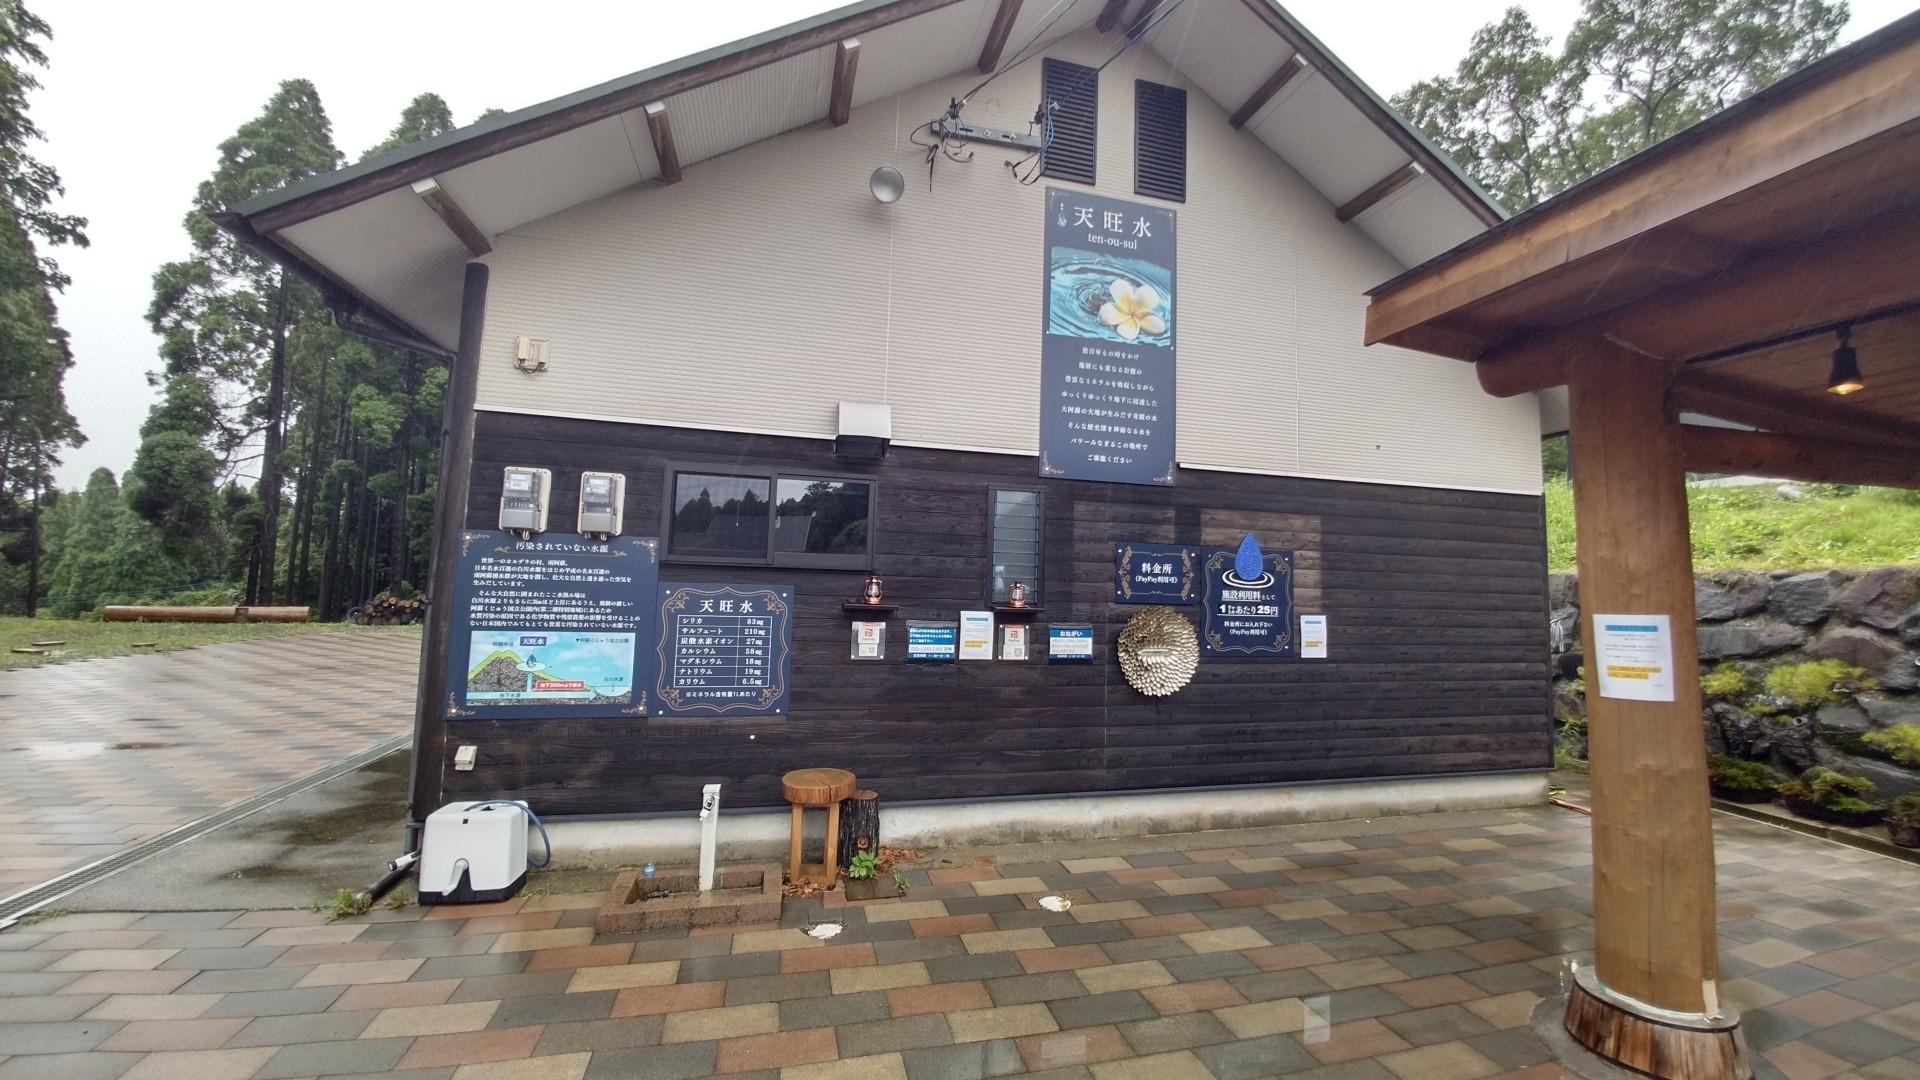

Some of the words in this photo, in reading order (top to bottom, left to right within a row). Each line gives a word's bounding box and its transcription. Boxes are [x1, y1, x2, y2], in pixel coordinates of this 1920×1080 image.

[1073, 207, 1152, 238] 天旺水
[1088, 233, 1137, 250] ten-ou-sui
[515, 542, 609, 553] 汚染されていない水源
[1141, 562, 1173, 575] 料金所
[472, 579, 526, 588] 生みだしています。
[1135, 576, 1178, 584] (PayPay利用可)
[1221, 589, 1276, 601] 施設利用料として
[699, 599, 753, 614] 天旺水
[1223, 620, 1273, 629] 料金所にお入れ下さい
[681, 627, 723, 635] サルフェート
[522, 637, 545, 646] 天旺水
[680, 637, 734, 645] 炭酸水素イオン
[679, 657, 722, 665] マグネシウム
